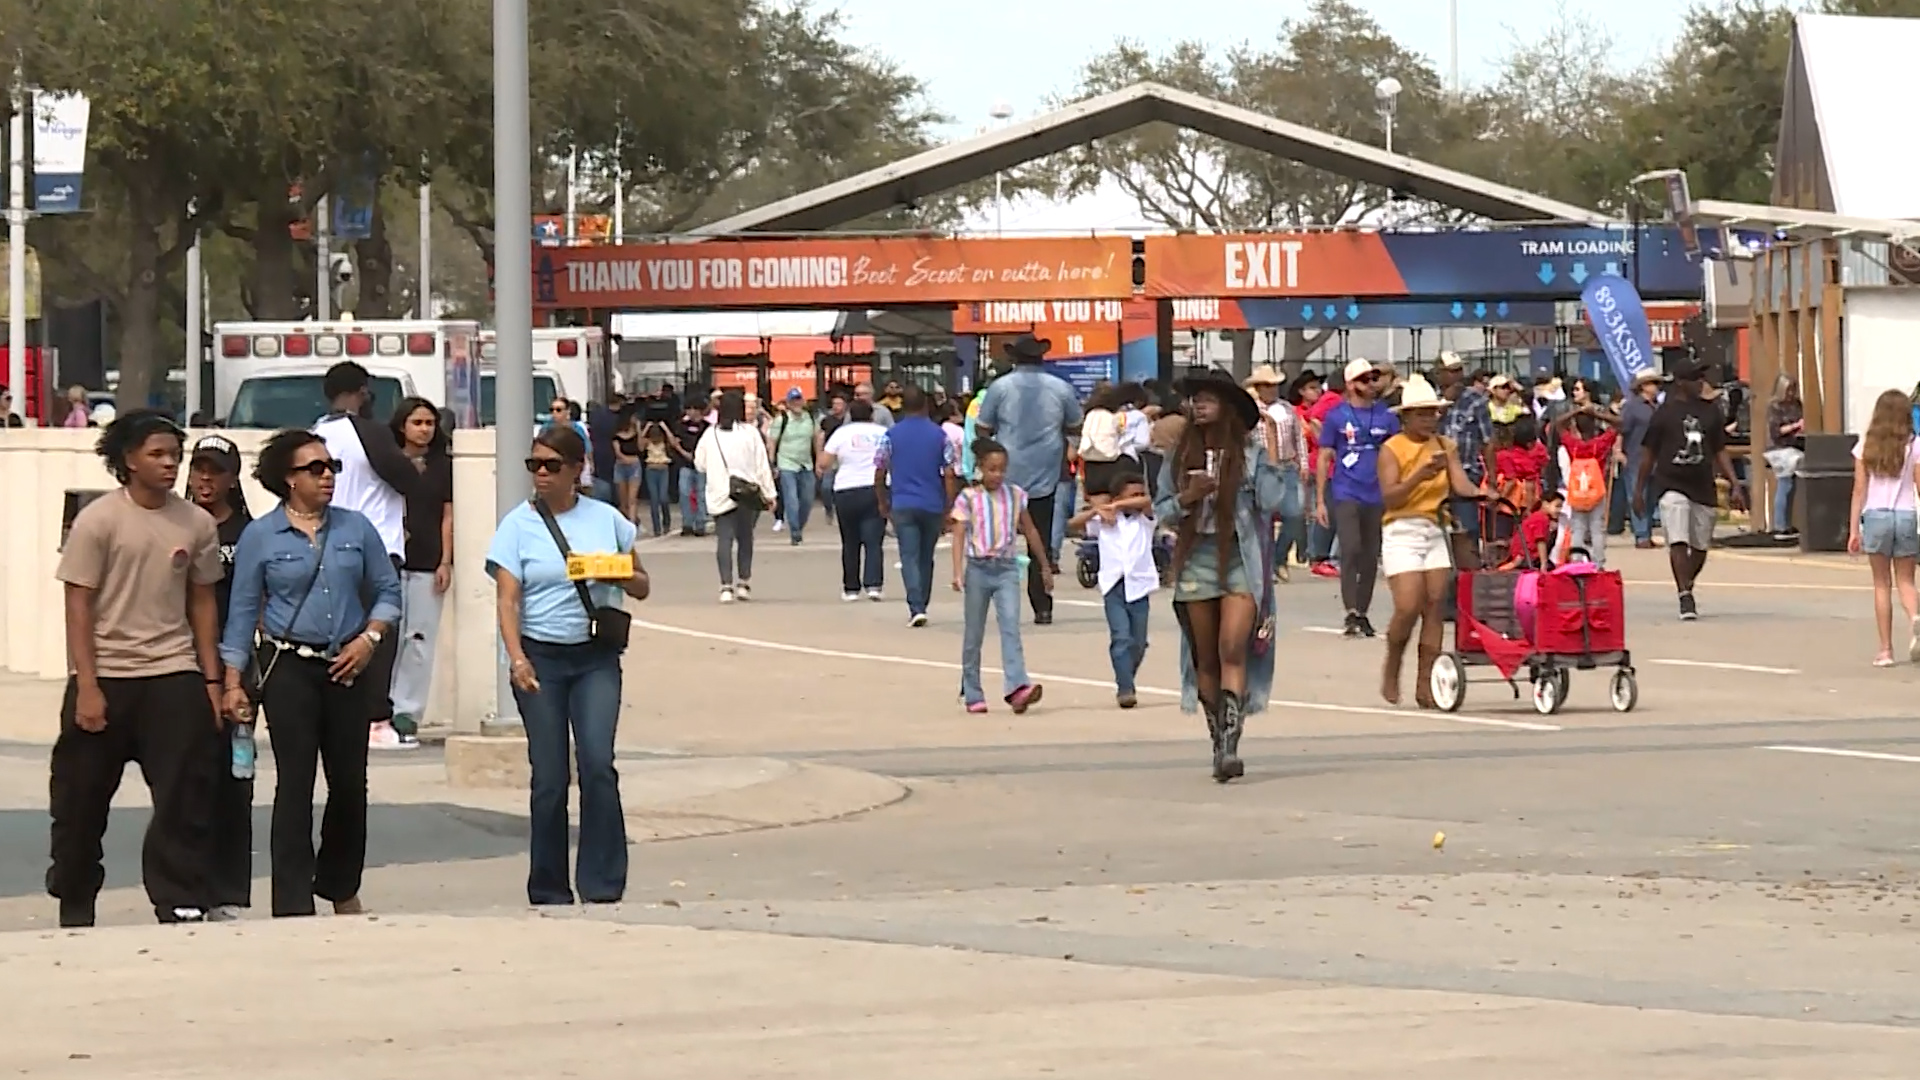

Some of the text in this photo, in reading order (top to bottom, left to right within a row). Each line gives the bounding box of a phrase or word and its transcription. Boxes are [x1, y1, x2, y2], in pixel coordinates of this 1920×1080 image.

[1521, 240, 1636, 255] TRAM LOADING
[567, 256, 848, 292] THANK YOU FOR COMING!
[853, 255, 899, 285] Boot
[904, 256, 970, 285] Scoot
[1001, 260, 1052, 283] outta
[1058, 252, 1116, 283] here!
[1225, 241, 1303, 288] EXIT
[1094, 300, 1123, 322] FO
[1497, 329, 1552, 346] EXIT
